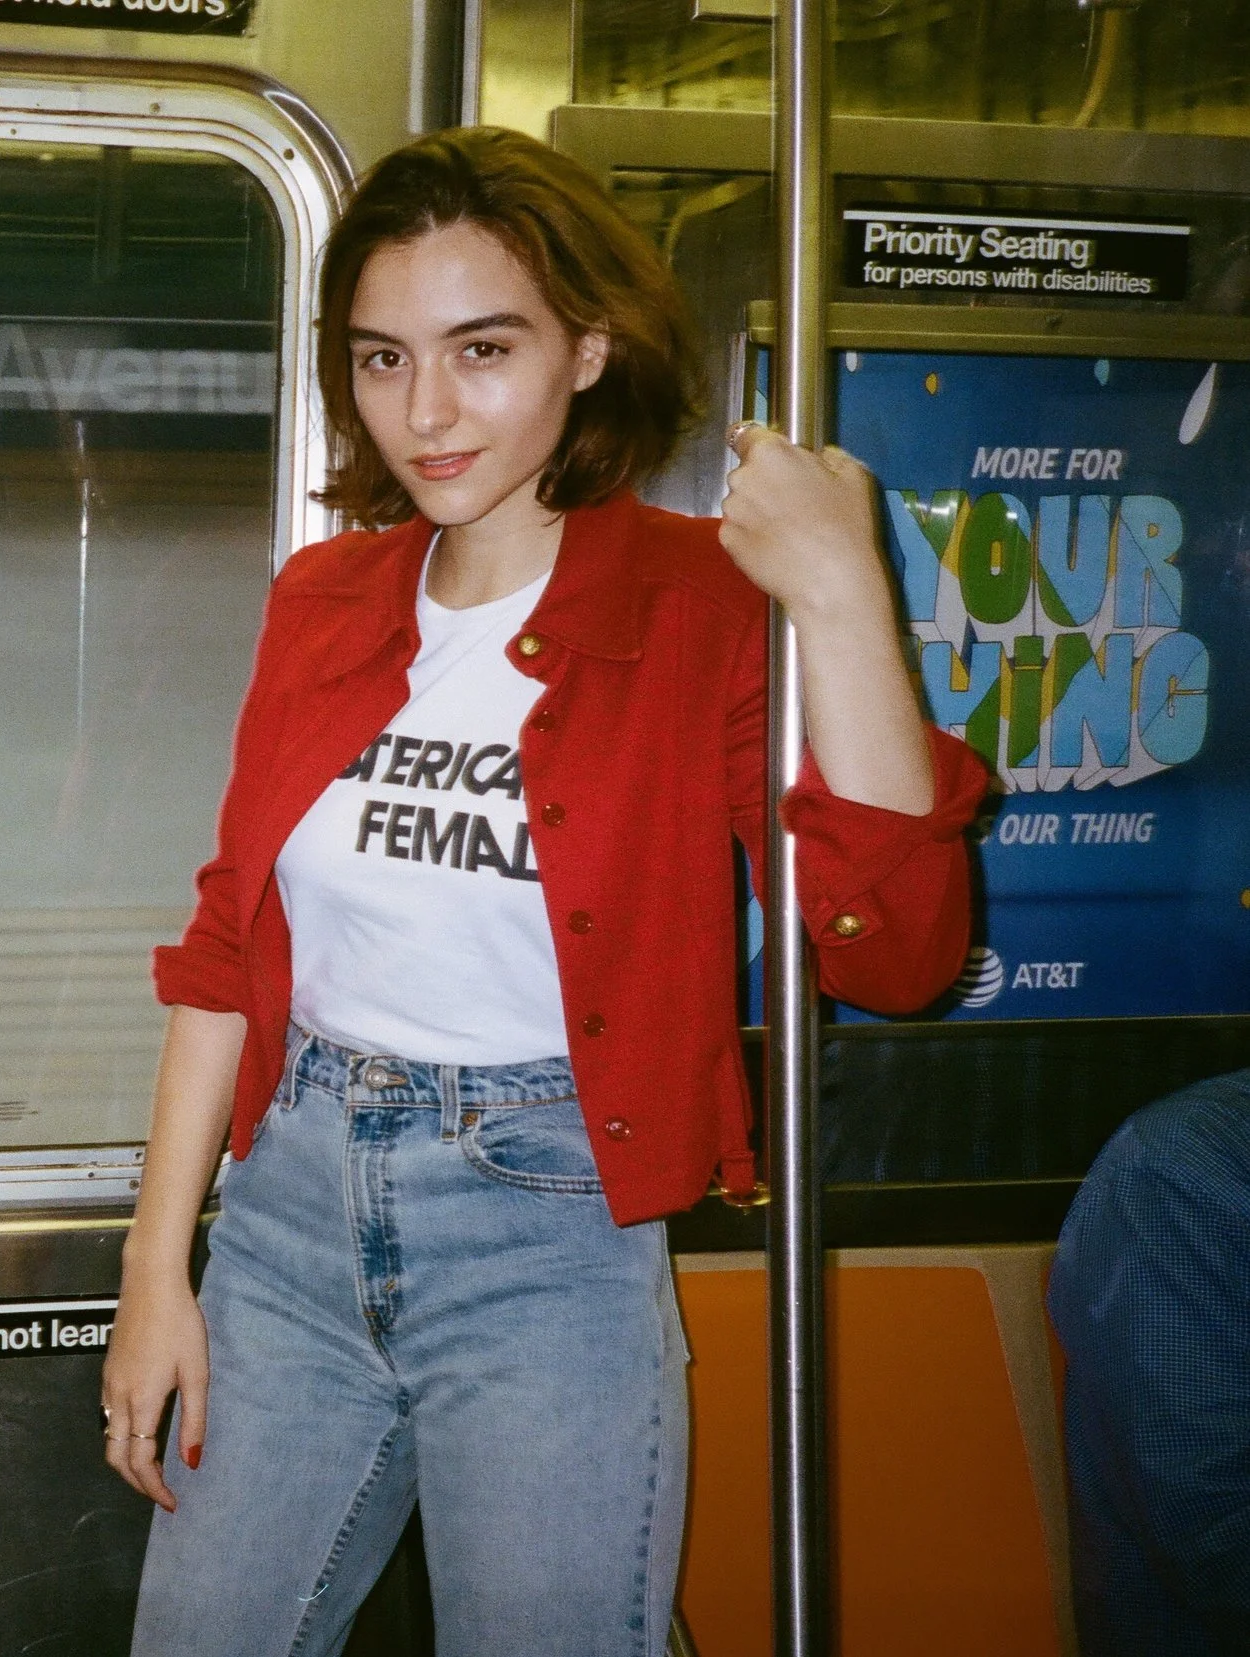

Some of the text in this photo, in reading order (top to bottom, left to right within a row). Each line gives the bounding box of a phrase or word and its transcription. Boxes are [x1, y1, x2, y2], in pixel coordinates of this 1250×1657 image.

[864, 221, 1091, 268] Priority Seating
[863, 260, 1152, 294] for persons with disabilities
[971, 446, 1123, 480] MORE FOR
[884, 489, 1184, 629] YOUR
[904, 631, 1210, 770] HING
[355, 799, 542, 883] FEMAL
[999, 814, 1061, 845] OUR
[1070, 813, 1155, 844] THING
[1012, 962, 1084, 989] AT&T
